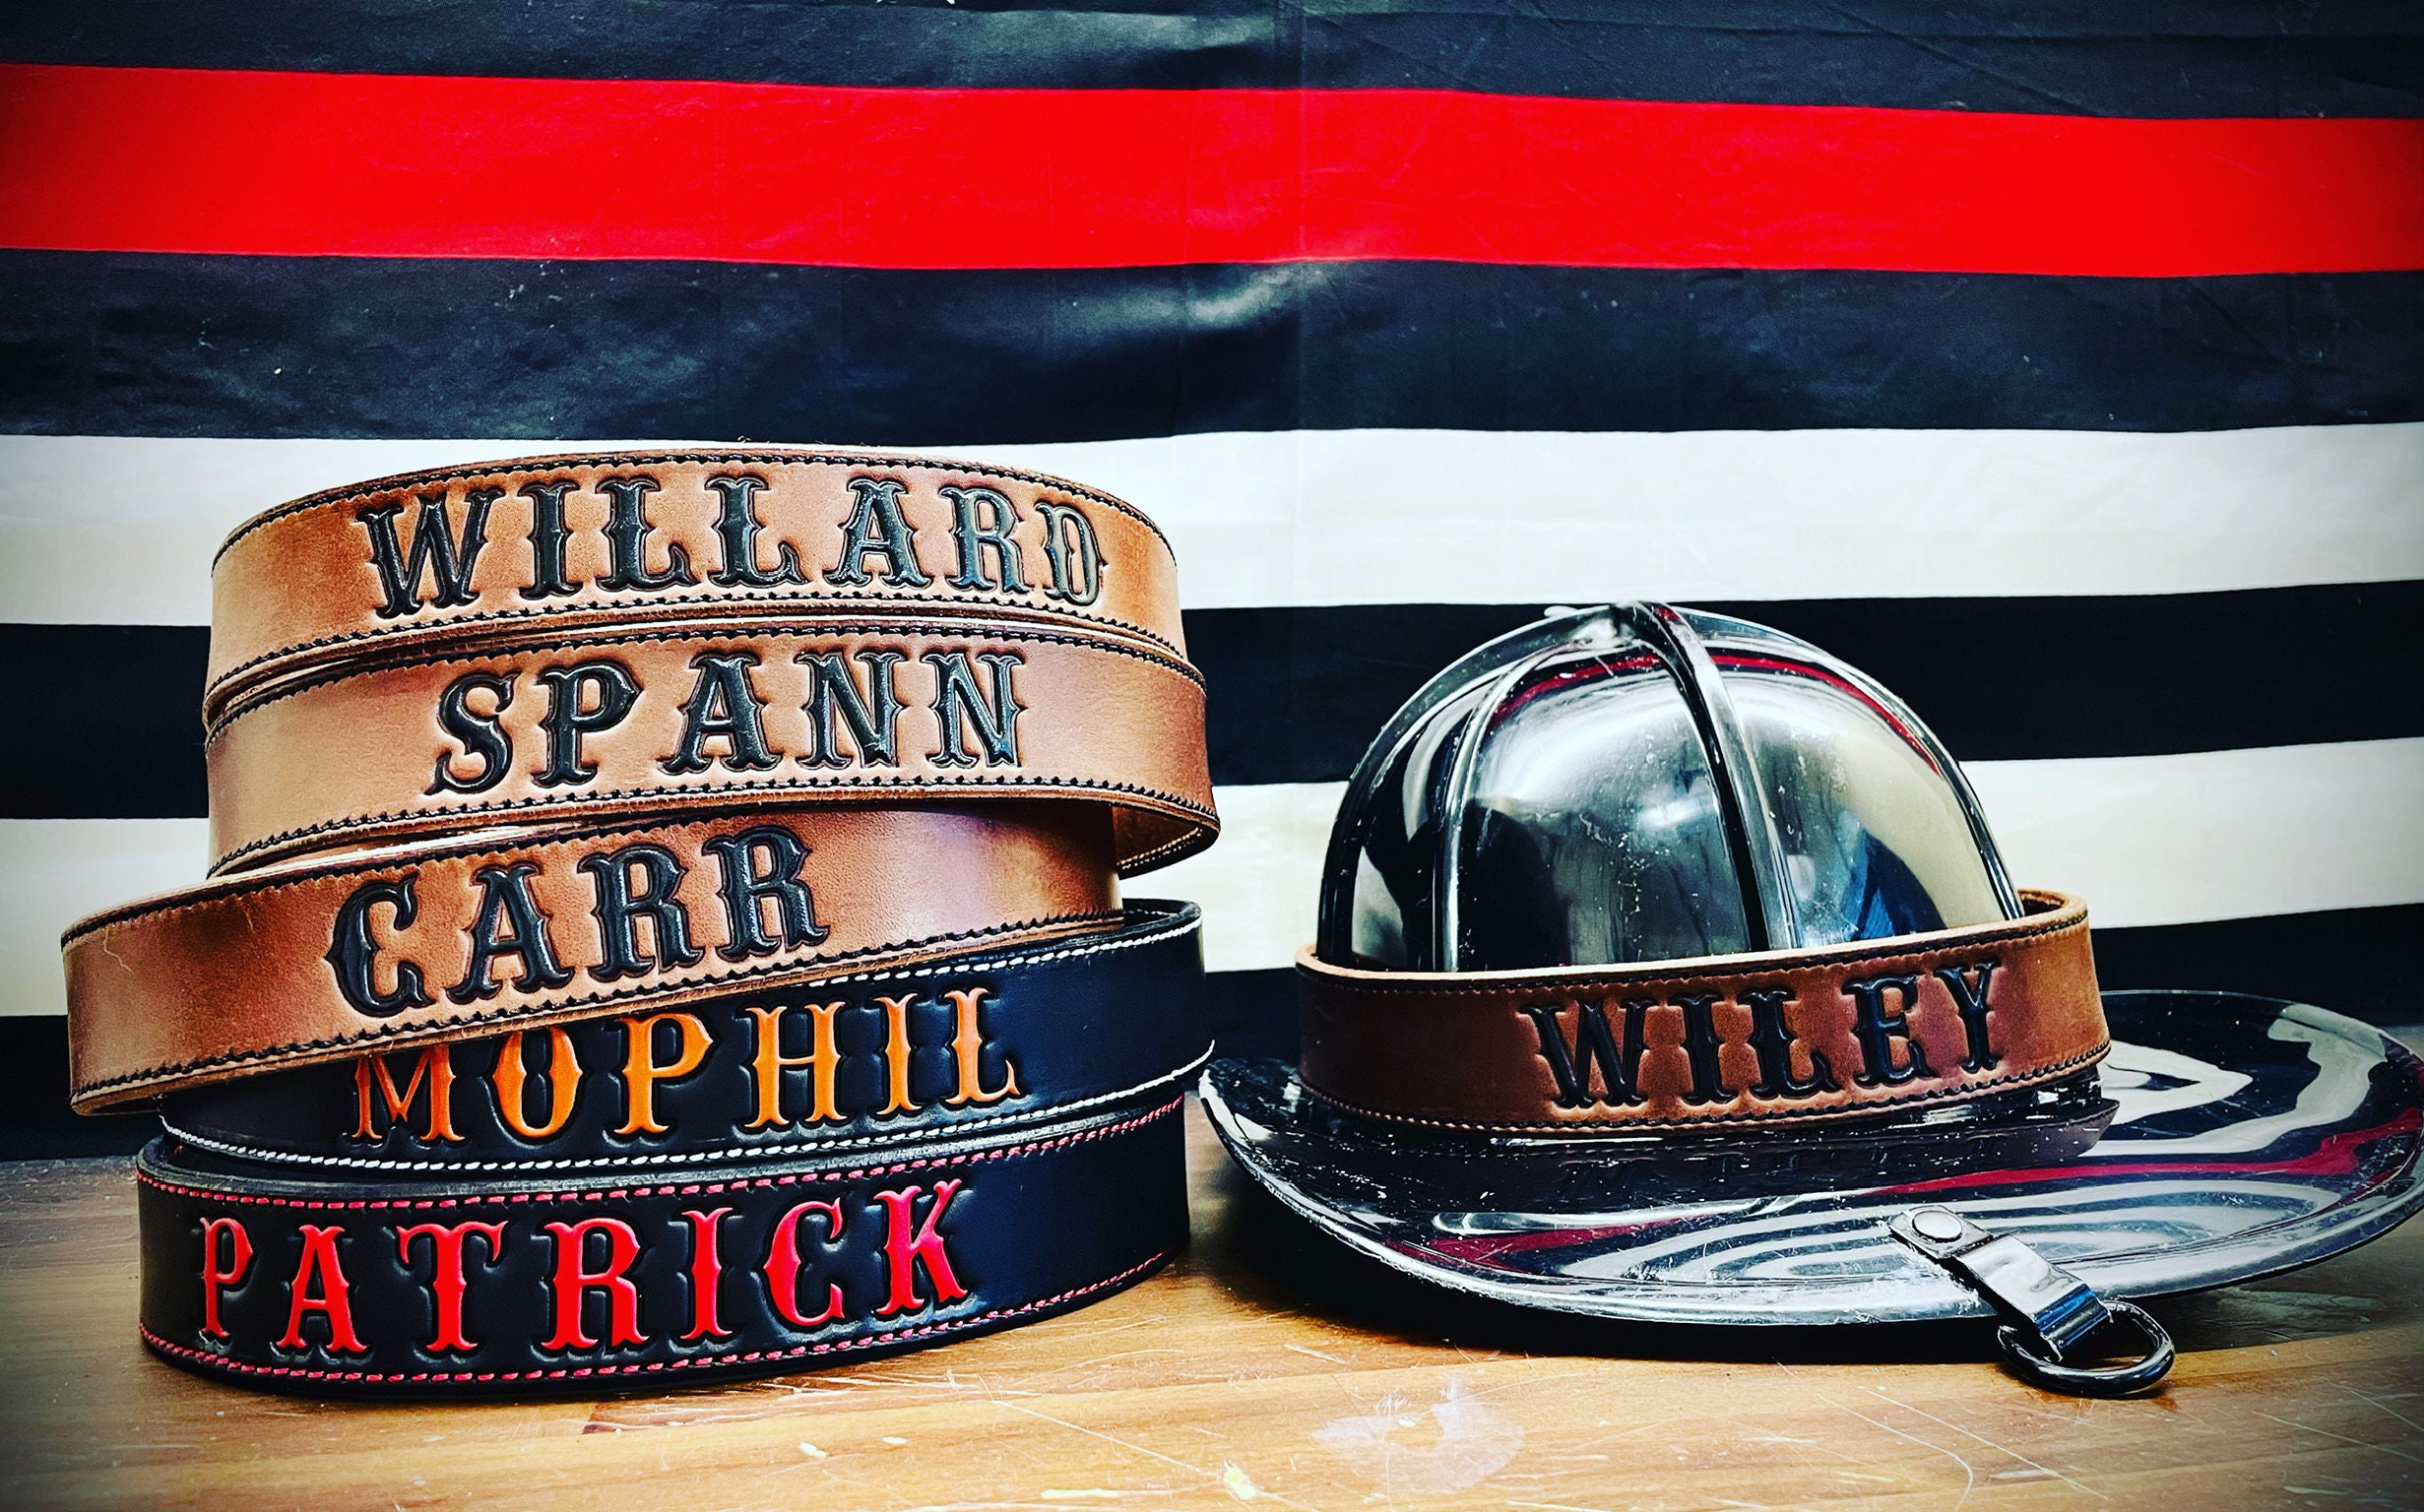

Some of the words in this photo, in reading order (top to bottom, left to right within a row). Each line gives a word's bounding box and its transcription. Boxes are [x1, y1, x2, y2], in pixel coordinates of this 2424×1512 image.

[358, 477, 1105, 617] WILLARD
[427, 653, 1025, 794] SPANN
[327, 828, 829, 1018] CARR
[351, 988, 1020, 1141] MOPHIL
[1527, 963, 2004, 1108] WILEY
[200, 1178, 969, 1352] PATRICK
